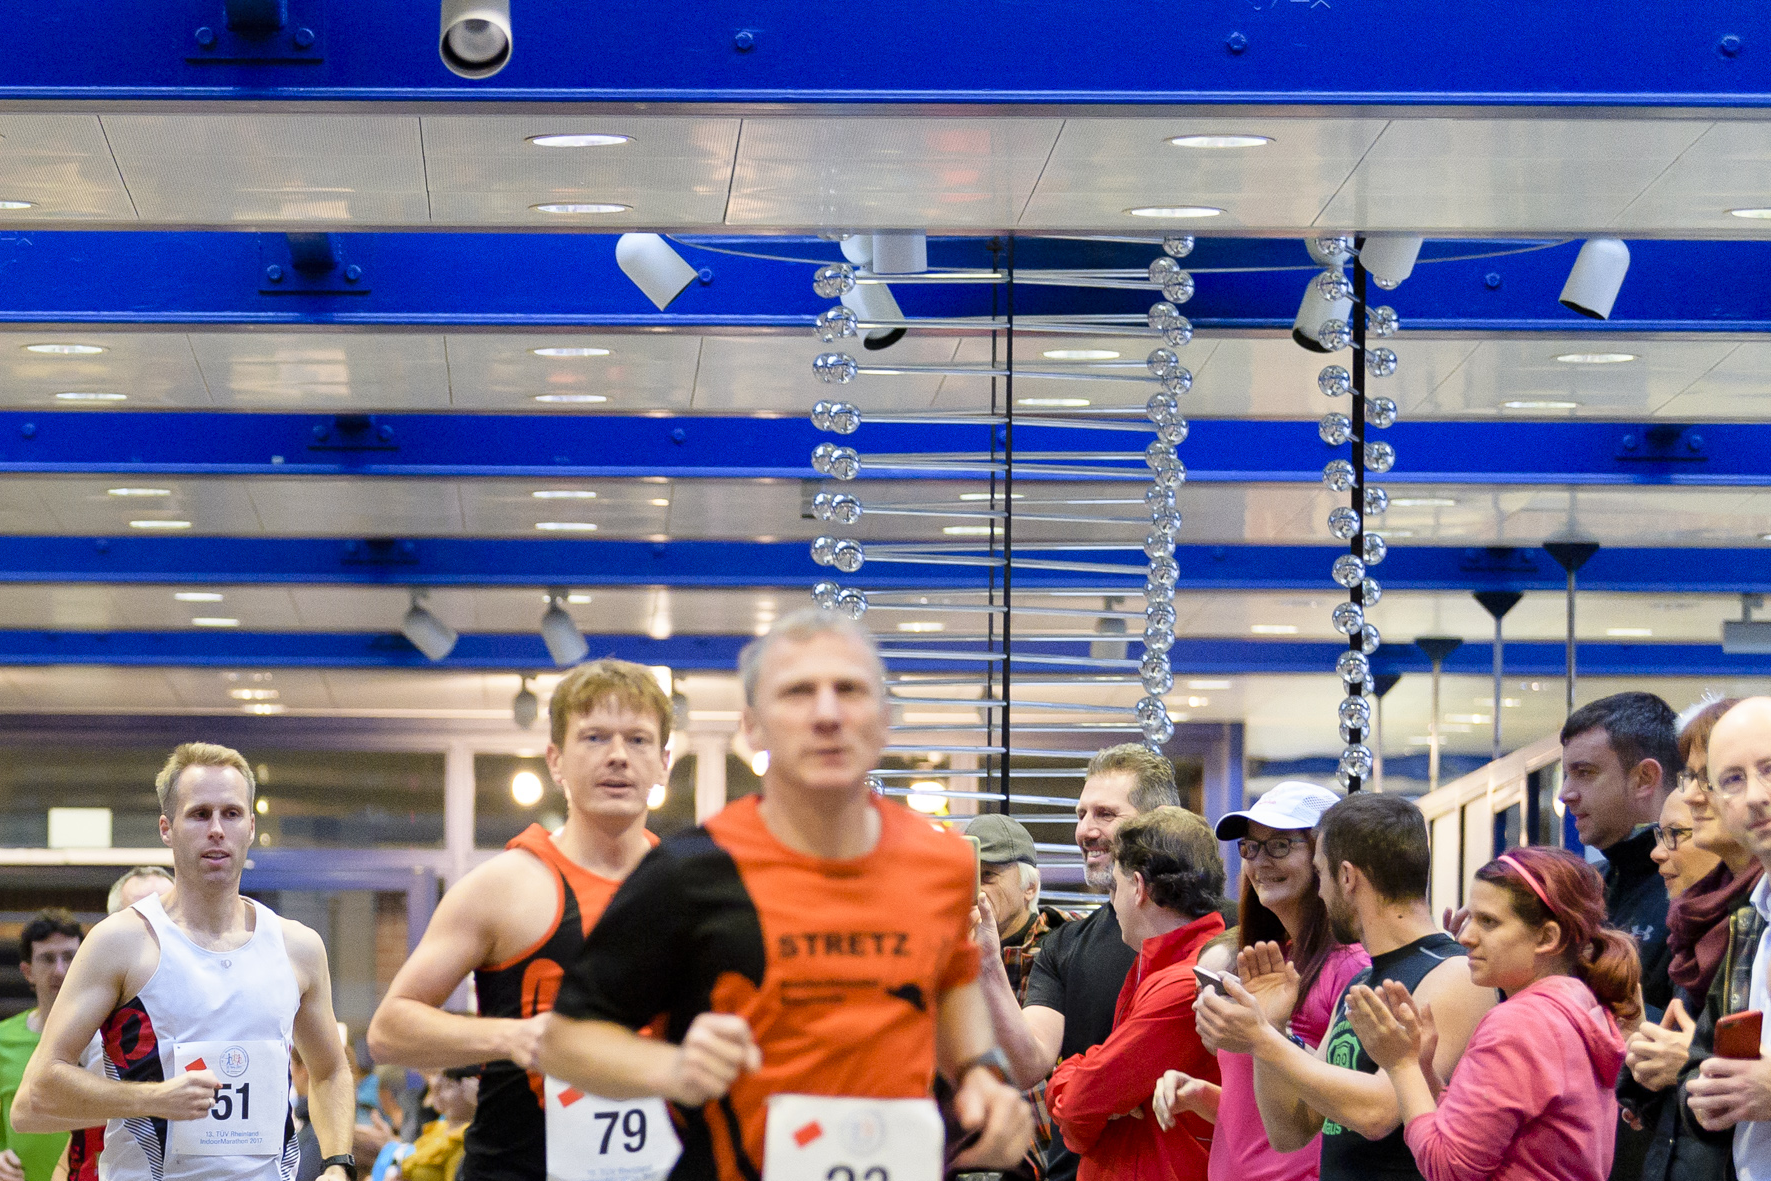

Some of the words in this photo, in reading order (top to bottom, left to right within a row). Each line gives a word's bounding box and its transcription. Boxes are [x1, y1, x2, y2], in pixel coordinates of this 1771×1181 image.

[779, 931, 910, 958] STRETZ
[210, 1082, 250, 1121] 51
[216, 1130, 229, 1138] TÜV
[594, 1108, 647, 1155] 79
